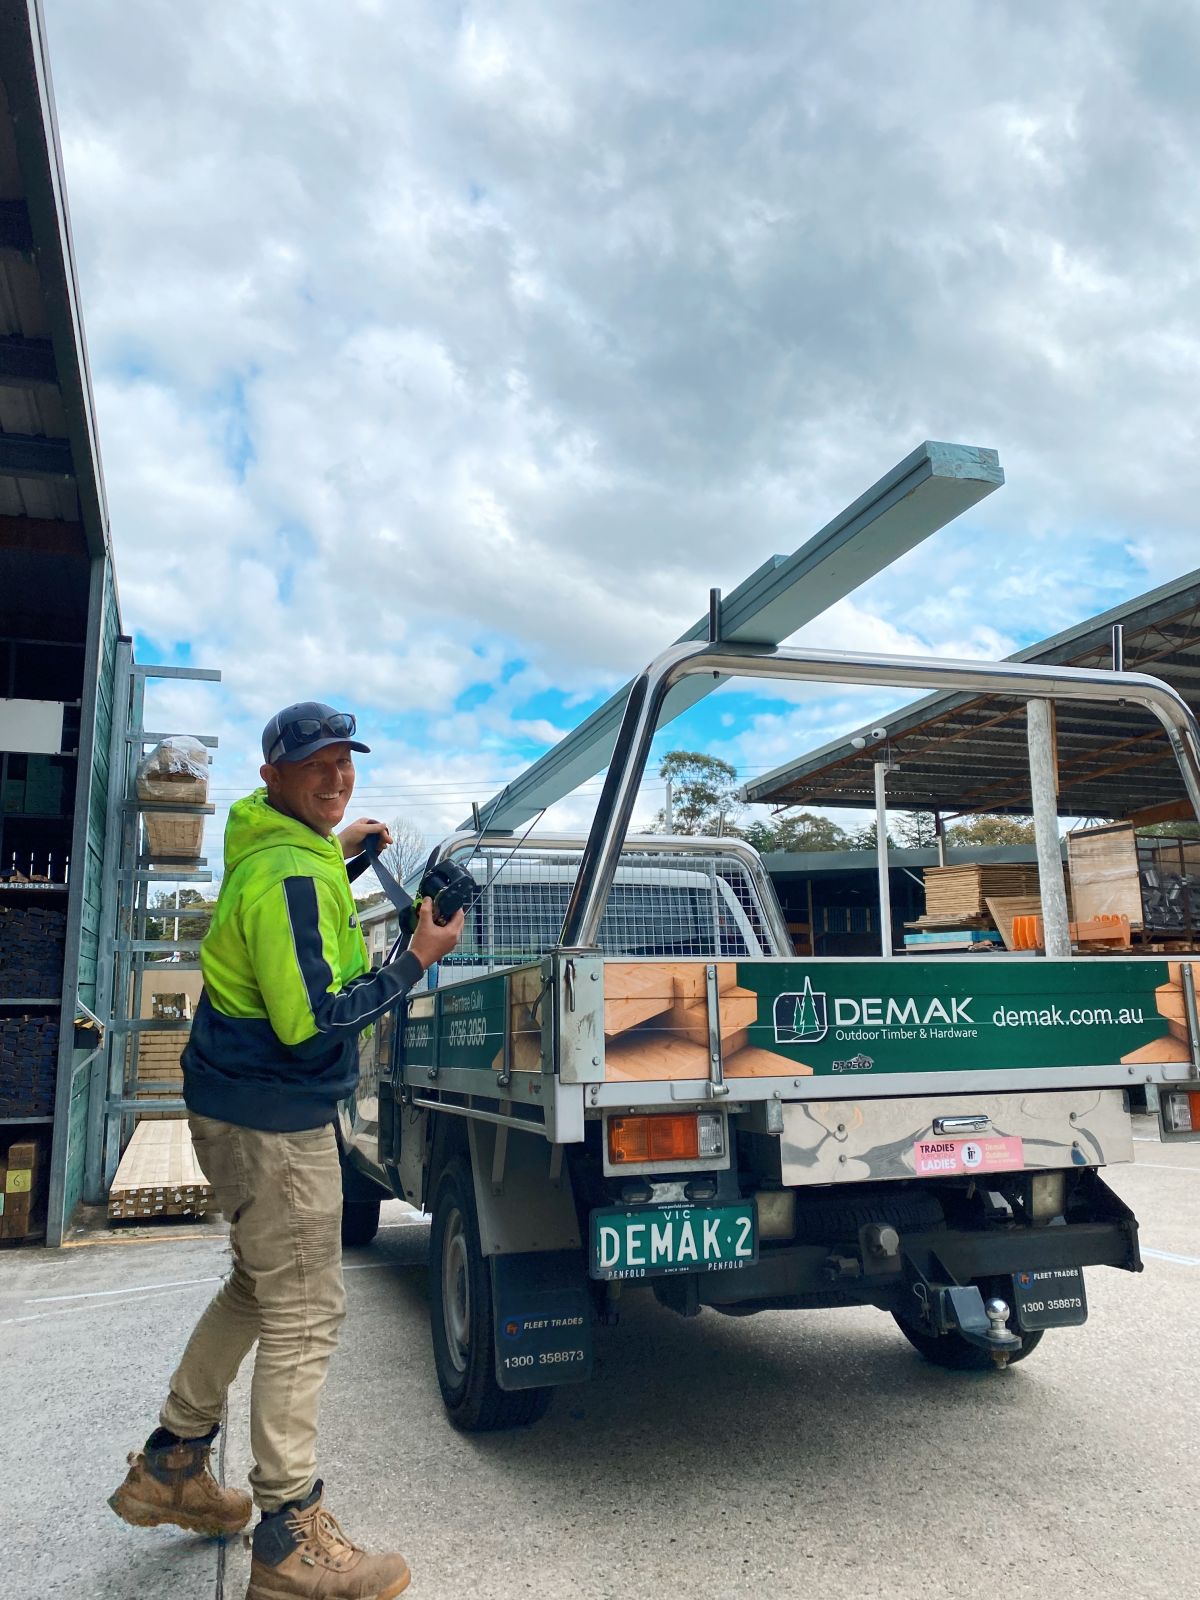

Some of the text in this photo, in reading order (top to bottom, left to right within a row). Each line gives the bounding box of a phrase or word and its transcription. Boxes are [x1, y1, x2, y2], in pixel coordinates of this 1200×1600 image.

[834, 997, 975, 1026] DEMAK
[992, 1004, 1144, 1027] demak.com.au
[835, 1027, 978, 1041] Outdoor Timber & Hardware
[920, 1143, 955, 1153] TRADIES
[921, 1159, 956, 1171] LADIES
[663, 1210, 690, 1221] VIC
[608, 1268, 646, 1279] PENFOLD
[708, 1259, 744, 1271] PENFOLD
[1033, 1272, 1053, 1281] FLEET
[1054, 1269, 1079, 1279] TRADES
[1022, 1298, 1082, 1313] 1300 358873
[523, 1320, 549, 1330] FLEET
[551, 1317, 584, 1328] TRADES
[504, 1350, 584, 1369] 1300 358873
